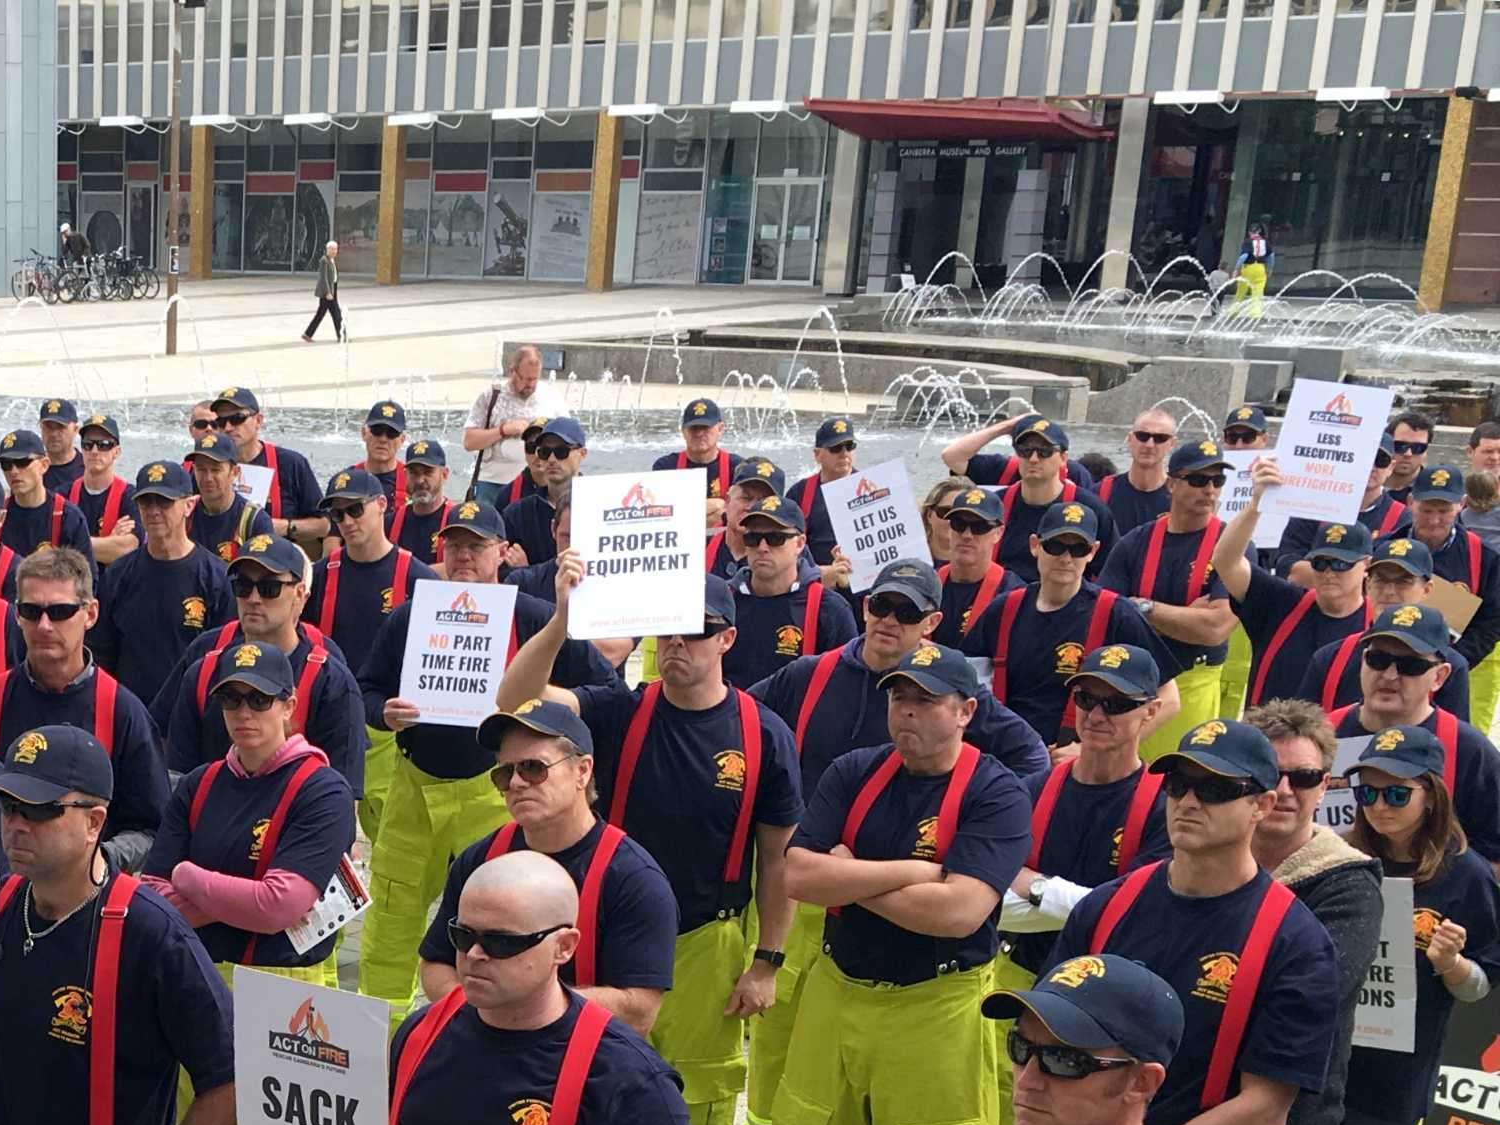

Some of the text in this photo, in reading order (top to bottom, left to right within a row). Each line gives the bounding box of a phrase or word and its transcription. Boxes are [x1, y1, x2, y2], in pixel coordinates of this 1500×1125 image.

[940, 147, 971, 156] MUSEUM
[975, 147, 990, 155] AND
[995, 146, 1027, 155] GALLERY
[1317, 432, 1342, 446] LESS
[1294, 445, 1355, 463] EXECUTIVES
[1304, 463, 1335, 475] MORE
[1280, 474, 1354, 494] IREFIGHTERS
[606, 509, 631, 521] ACT
[853, 506, 897, 532] LET US
[598, 531, 678, 552] PROPER
[855, 523, 906, 551] DO OUR
[587, 553, 690, 577] EQUIPMENT
[874, 545, 899, 565] JOB
[429, 634, 492, 651] NO PART
[422, 654, 491, 672] TIME FIRE
[418, 674, 488, 694] STATIONS
[1326, 805, 1355, 826] US
[272, 1037, 347, 1066] ACT ON FIRE
[1435, 1073, 1498, 1110] ACT
